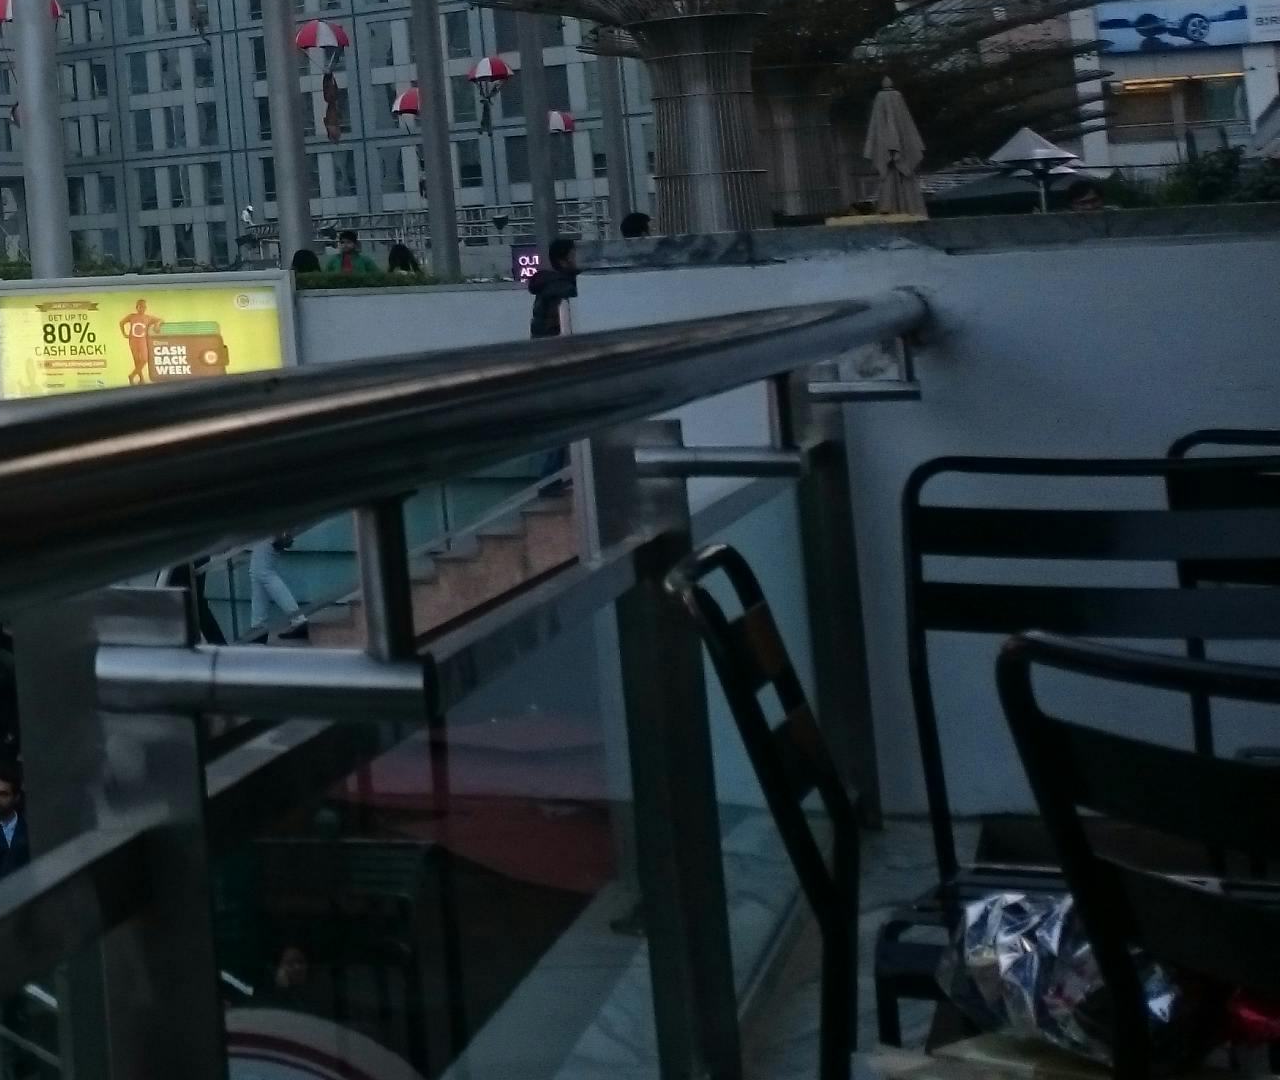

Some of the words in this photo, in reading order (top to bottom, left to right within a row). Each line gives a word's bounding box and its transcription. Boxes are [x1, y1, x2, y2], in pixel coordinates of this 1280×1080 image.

[48, 314, 62, 322] GET
[78, 313, 88, 321] TO
[43, 322, 96, 344] 80%
[35, 345, 66, 357] CASH
[70, 344, 106, 356] BACK!
[153, 345, 187, 356] CASH
[154, 355, 188, 366] BACK
[155, 365, 192, 375] WEEK
